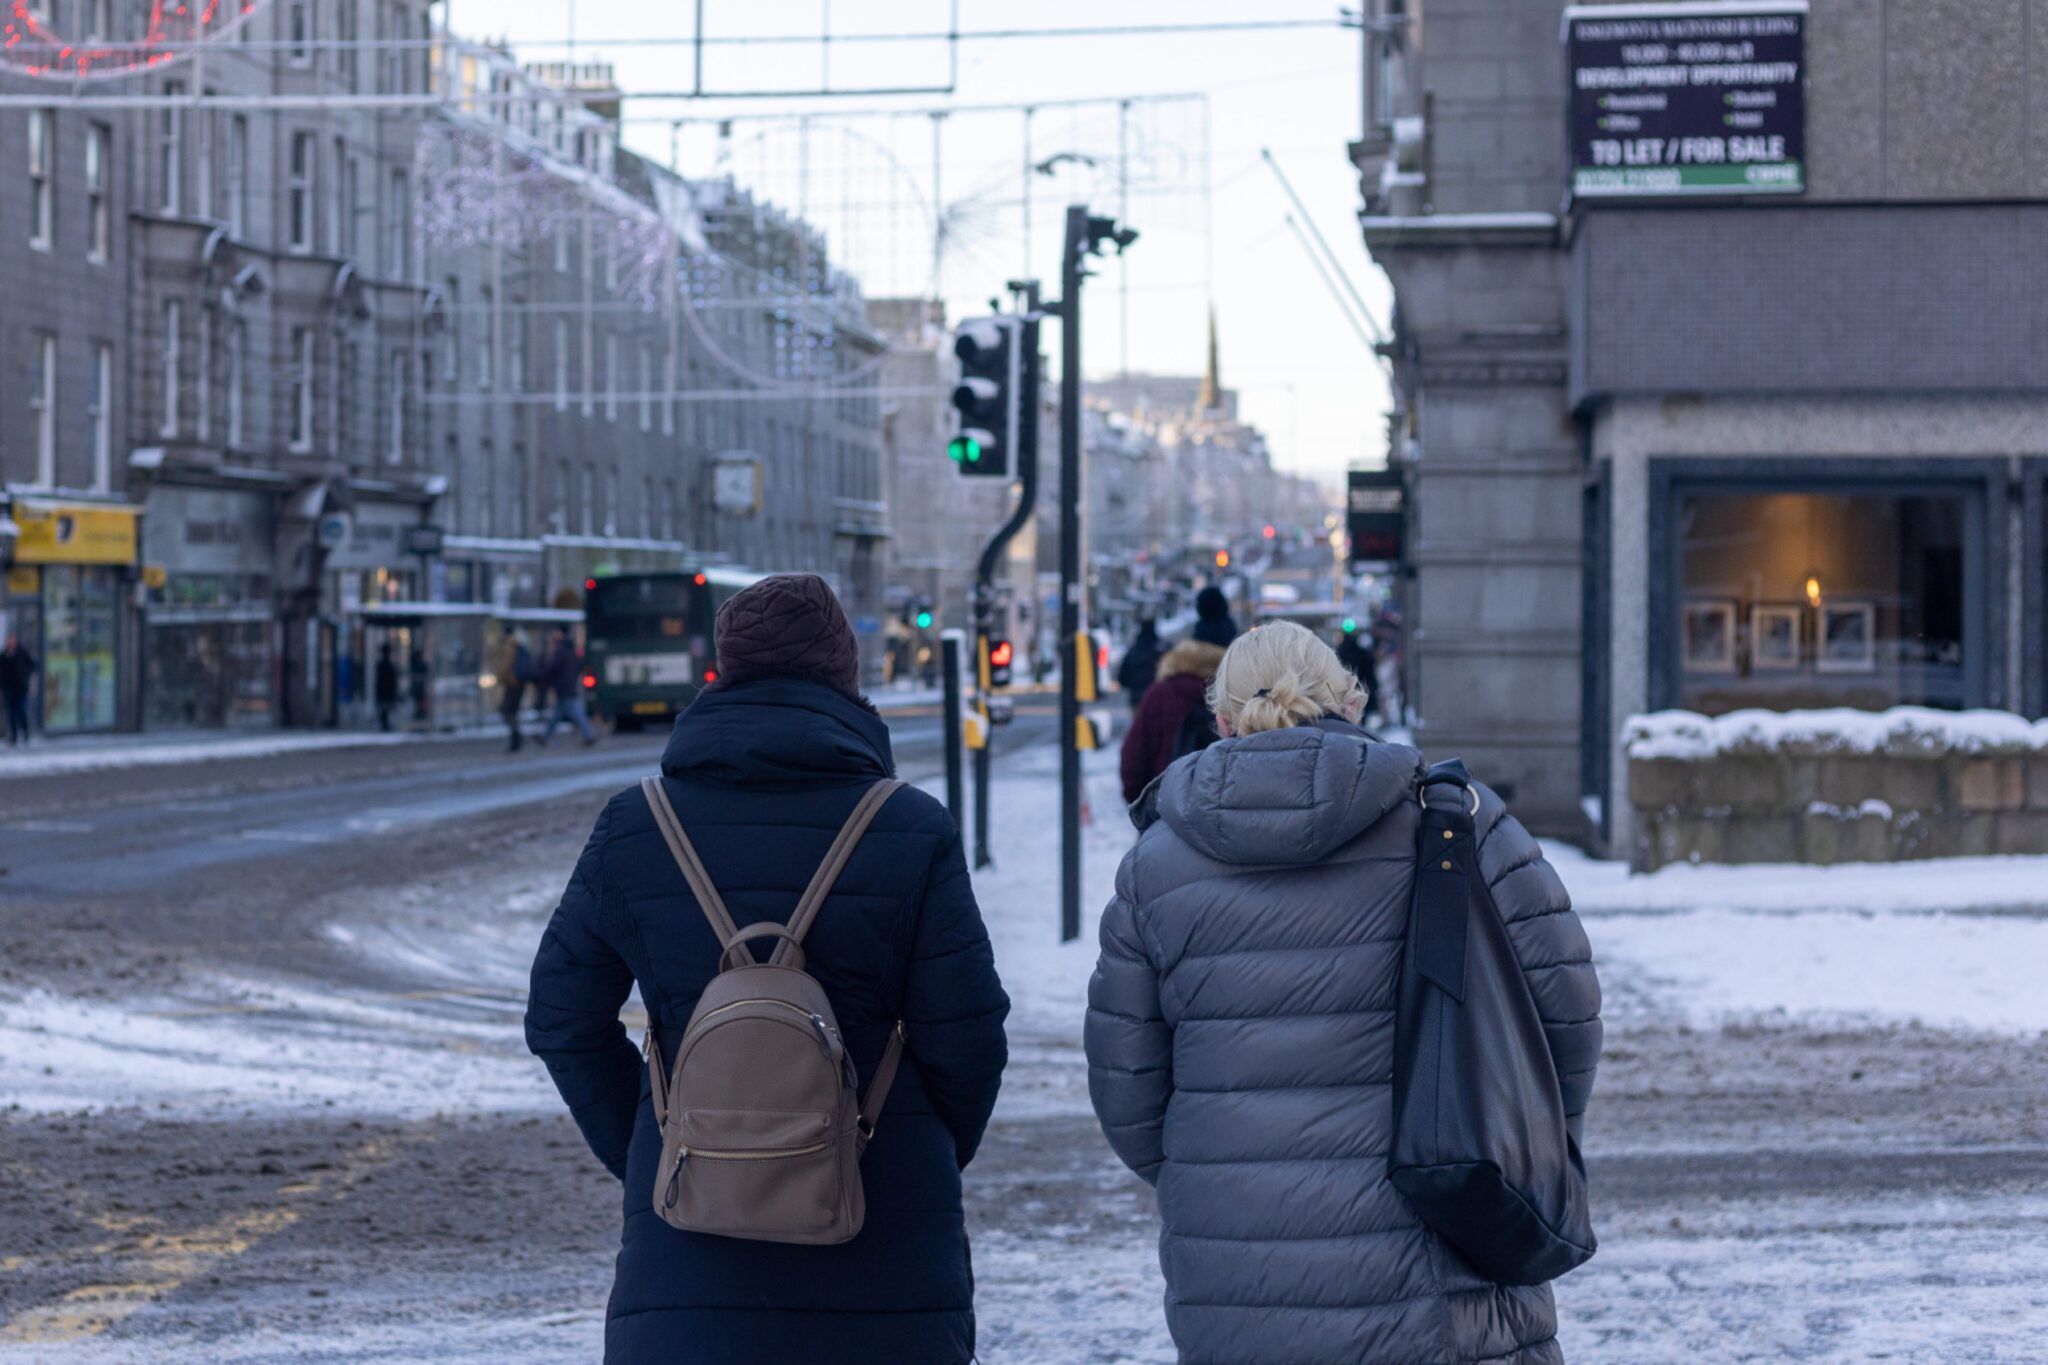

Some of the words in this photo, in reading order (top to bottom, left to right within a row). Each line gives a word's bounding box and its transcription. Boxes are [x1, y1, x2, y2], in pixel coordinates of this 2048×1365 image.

[1577, 67, 1688, 87] DEVELOPMENT
[1689, 63, 1797, 84] OPPORTUNITY
[1591, 140, 1621, 164] TO
[1624, 139, 1664, 164] LET
[1667, 138, 1679, 163] /
[1681, 137, 1725, 162] FOR
[1727, 136, 1785, 161] SALE
